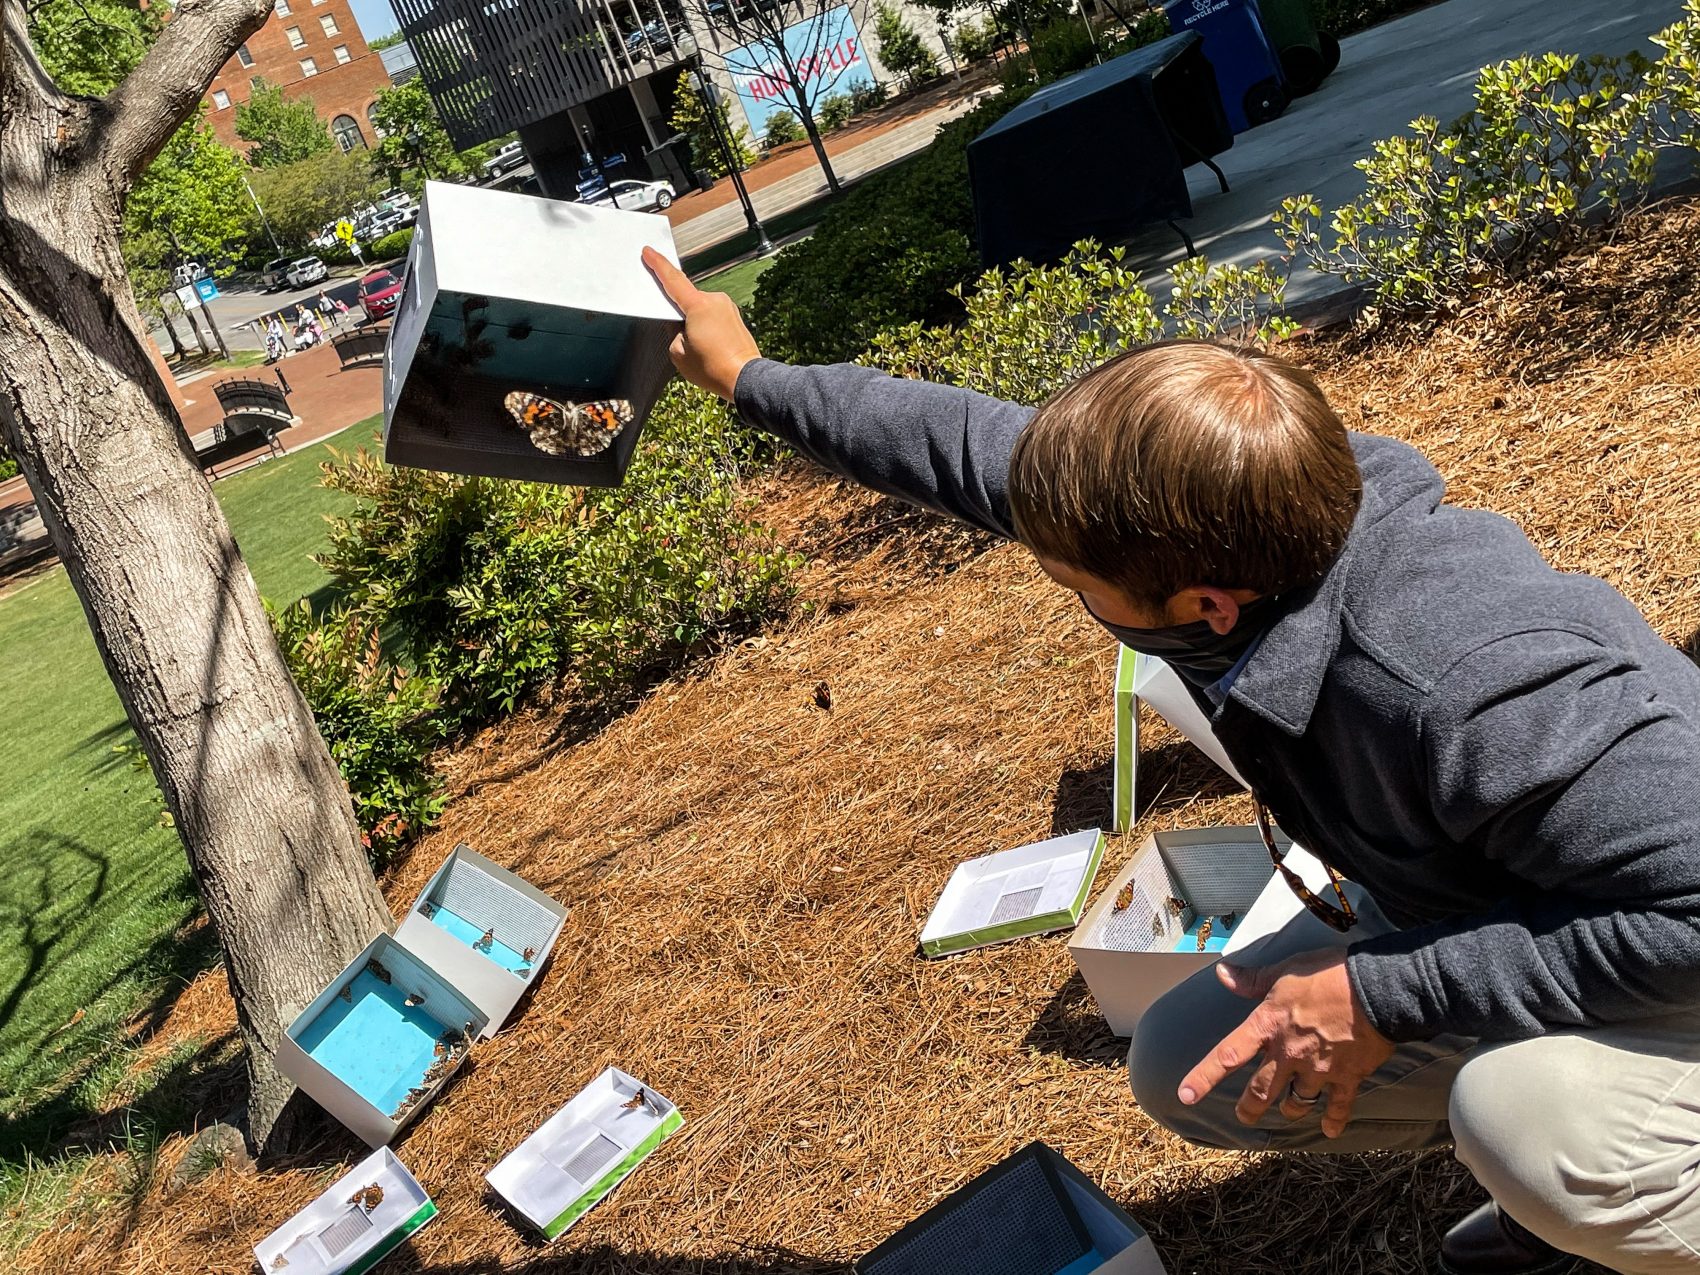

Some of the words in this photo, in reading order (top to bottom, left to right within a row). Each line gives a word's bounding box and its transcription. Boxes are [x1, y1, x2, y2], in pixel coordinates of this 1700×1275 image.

[1183, 6, 1213, 26] RECYCLE
[1212, 0, 1230, 12] HERE
[748, 37, 860, 103] HUNSVLLE
